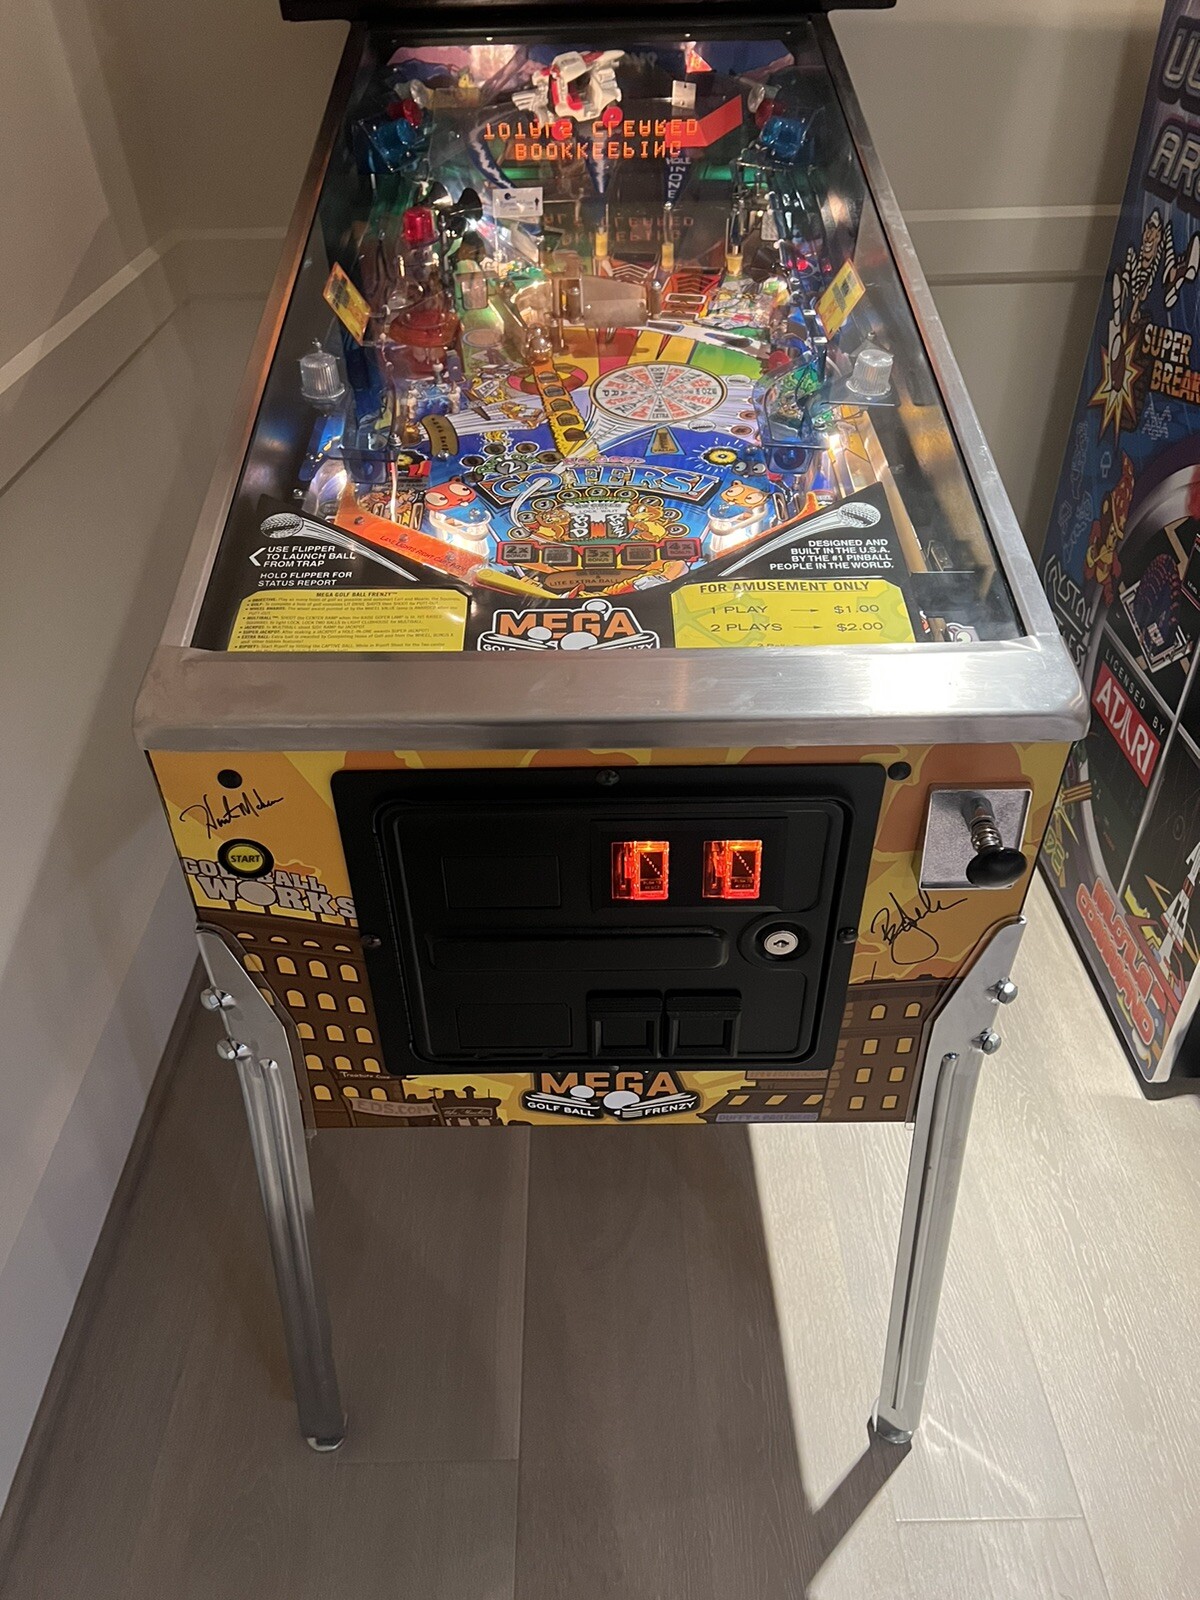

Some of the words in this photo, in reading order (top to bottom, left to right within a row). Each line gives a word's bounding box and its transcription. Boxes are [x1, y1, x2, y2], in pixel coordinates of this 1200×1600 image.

[1142, 323, 1193, 366] SUPER
[808, 539, 863, 548] DESIGNED
[865, 538, 889, 547] AND
[267, 545, 288, 553] USE
[291, 545, 336, 553] FLIPPER
[790, 547, 822, 556] BUILT
[823, 547, 836, 555] IN
[837, 547, 857, 555] THE
[859, 546, 891, 555] U.S.A.
[266, 553, 280, 561] TO
[282, 552, 326, 561] LAUNCH
[328, 552, 356, 560] BALL
[791, 555, 805, 563] BY
[807, 554, 829, 563] THE
[832, 554, 843, 562] #1
[845, 554, 893, 562] PINBALL
[263, 560, 294, 568] FROM
[296, 559, 325, 568] TRAP
[769, 562, 813, 571] PEOPLE
[815, 562, 827, 571] IN
[828, 562, 850, 570] THE
[852, 561, 895, 570] WORLD.
[260, 572, 288, 580] HOLD
[289, 572, 330, 580] FLIPPER
[332, 571, 353, 579] FOR
[257, 580, 298, 588] STATUS
[299, 579, 337, 587] REPORT
[700, 584, 728, 593] FOR
[734, 582, 832, 593] AMUSEMENT
[835, 581, 870, 592] ONLY
[710, 606, 718, 614] 1
[723, 605, 769, 614] PLAY
[833, 604, 880, 614] $1.00
[499, 612, 637, 640] MEGA
[710, 623, 721, 632] 2
[726, 622, 783, 632] PLAYS
[837, 622, 884, 632] $2.00
[1105, 647, 1147, 710] LICENSED
[1152, 716, 1166, 737] BY
[1096, 677, 1155, 776] ATARI
[230, 854, 261, 863] START
[541, 1071, 680, 1097] MEGA
[357, 1101, 431, 1115] EDS.COM
[527, 1102, 560, 1113] GOLF
[563, 1107, 595, 1118] BALL
[644, 1101, 695, 1116] FRENZY
